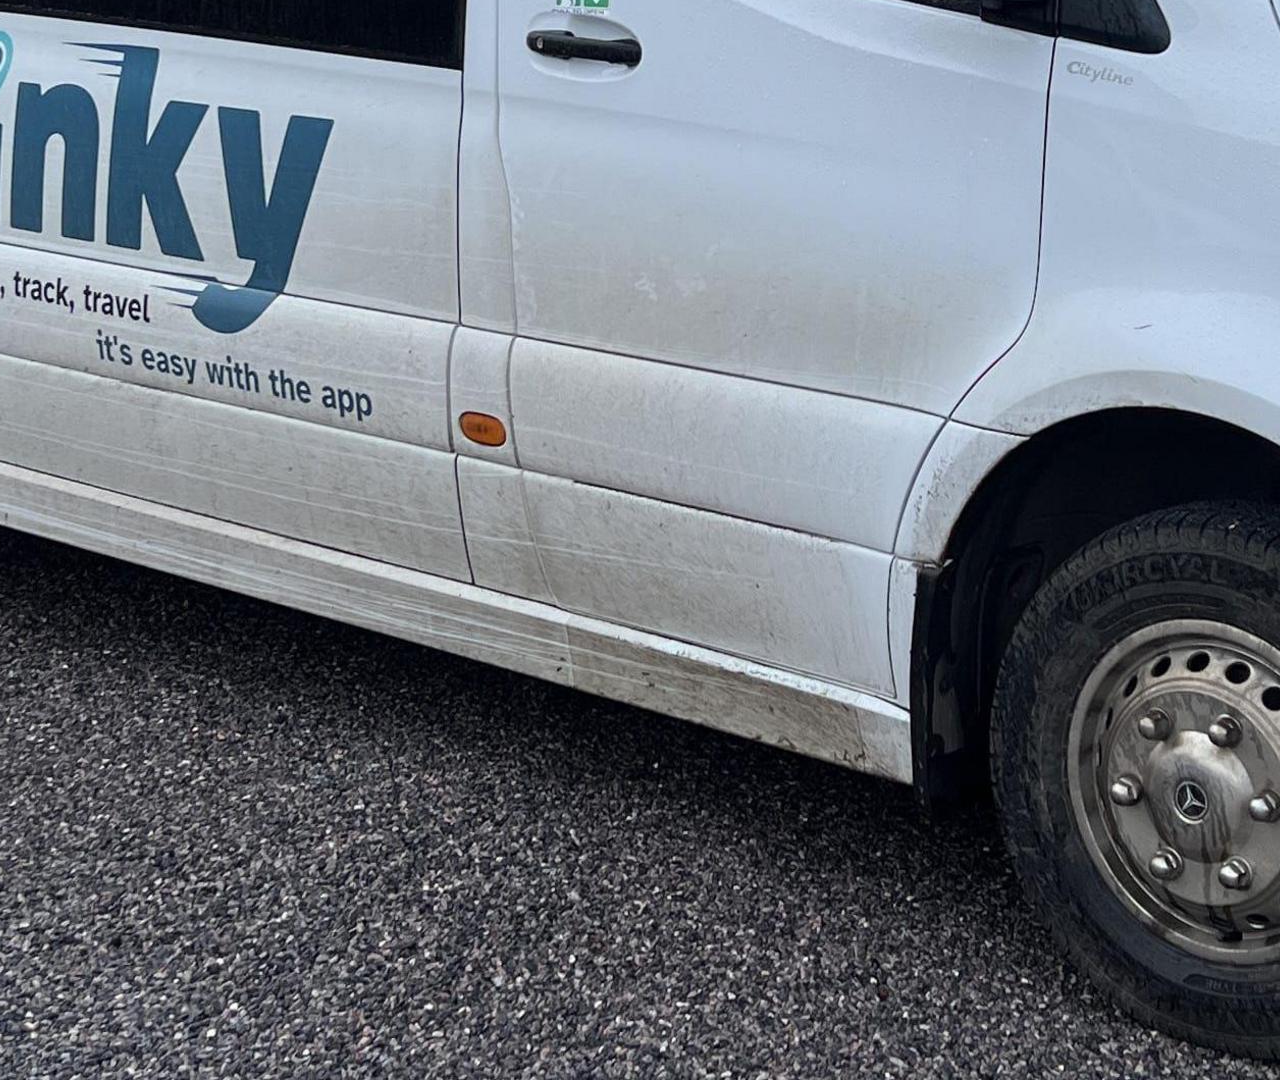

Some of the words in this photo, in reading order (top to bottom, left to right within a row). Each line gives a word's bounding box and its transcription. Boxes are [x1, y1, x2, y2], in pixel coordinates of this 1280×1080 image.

[1066, 61, 1134, 86] Cityline
[13, 270, 75, 313] track,
[83, 288, 151, 323] travel
[96, 328, 134, 366] it's
[141, 348, 197, 385] easy
[206, 355, 260, 394] with
[268, 369, 312, 404] the
[321, 384, 373, 421] app
